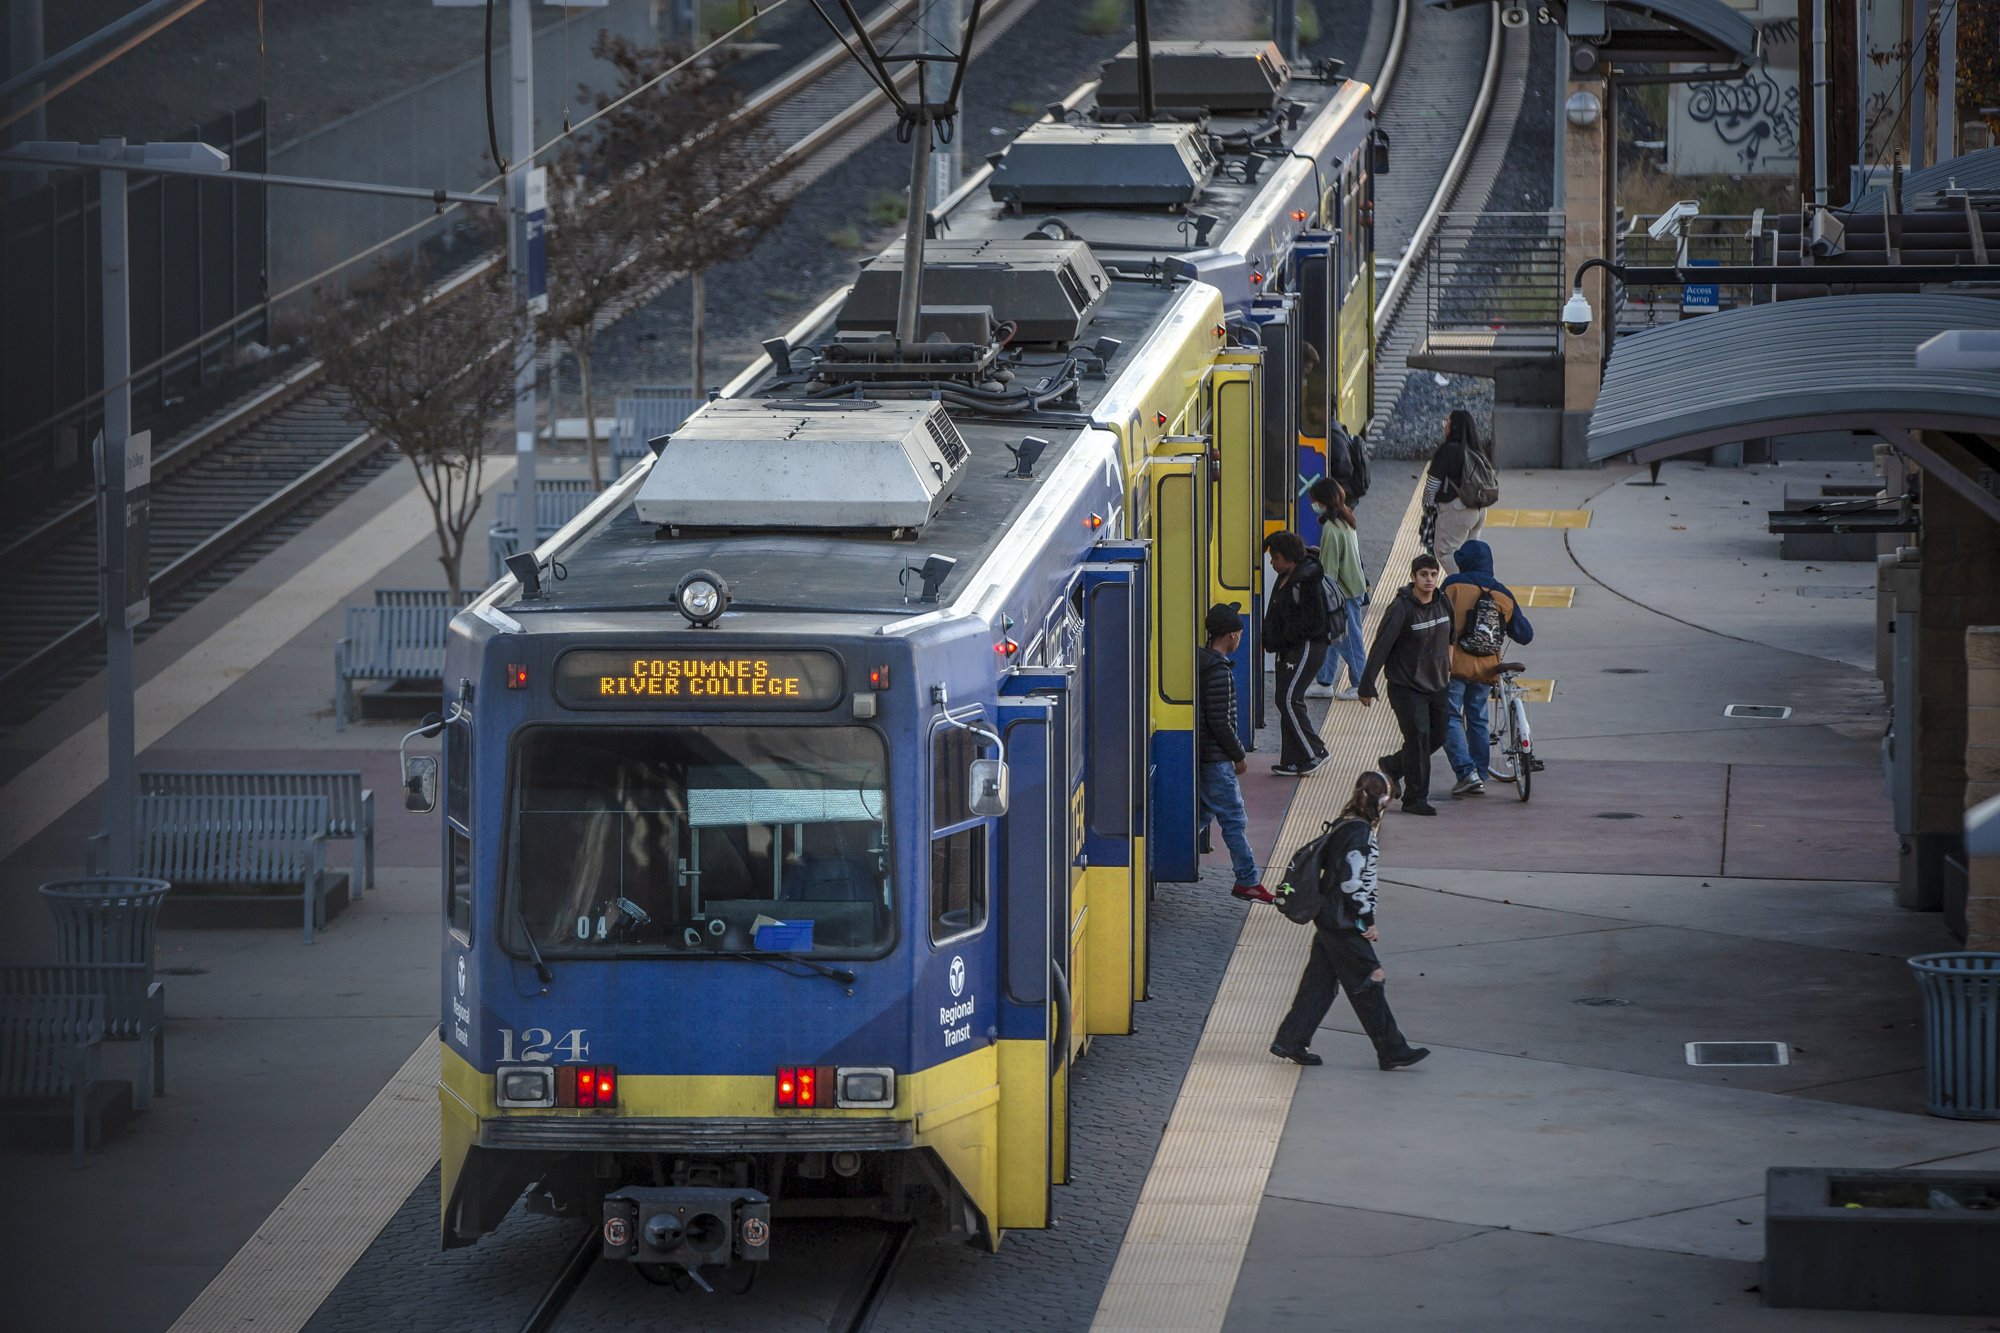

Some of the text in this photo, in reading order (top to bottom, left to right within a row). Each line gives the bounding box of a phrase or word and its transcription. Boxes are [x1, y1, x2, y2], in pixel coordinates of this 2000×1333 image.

[1686, 286, 1712, 295] Access
[1686, 295, 1710, 306] Ramp
[132, 453, 145, 469] College
[633, 660, 769, 678] COSUMNES
[600, 677, 800, 695] RIVER COLLEGE
[453, 997, 470, 1025] Regional
[939, 995, 975, 1027] Regional
[454, 1021, 469, 1048] Transit
[496, 1028, 589, 1062] 124
[943, 1022, 971, 1048] Transit
